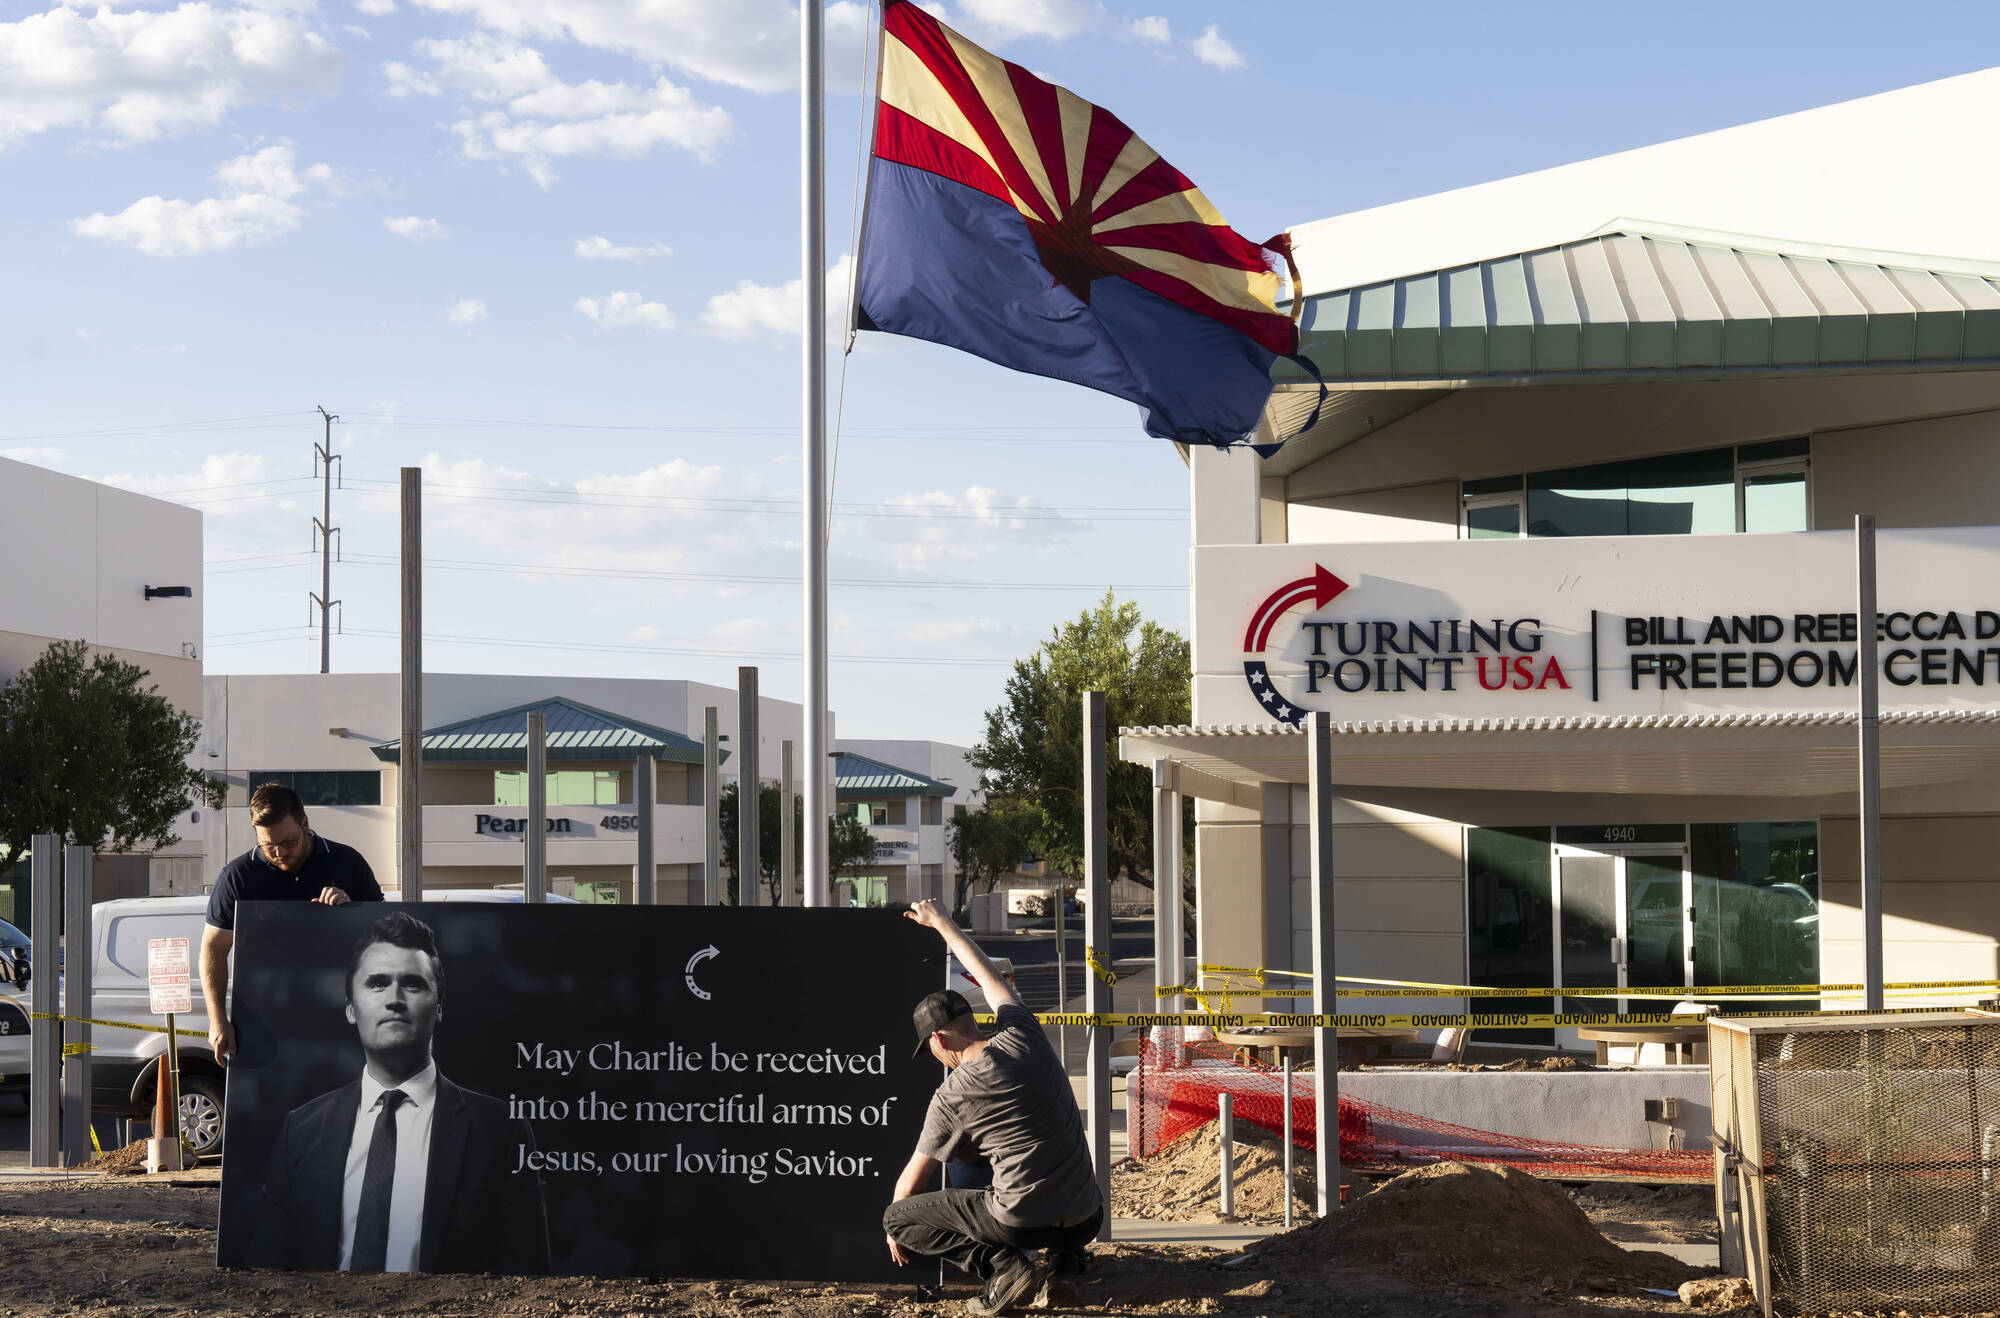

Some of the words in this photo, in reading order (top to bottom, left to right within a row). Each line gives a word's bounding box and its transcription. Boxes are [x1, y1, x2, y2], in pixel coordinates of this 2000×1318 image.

[1625, 616, 1695, 646] BILL
[1704, 614, 1784, 645] AND
[1302, 618, 1544, 656] TURNING
[1304, 657, 1463, 693] POINT
[1475, 656, 1572, 690] USA
[1631, 650, 1858, 690] FREEDOM
[475, 814, 572, 834] Pearon
[600, 815, 638, 829] 4950
[1604, 827, 1635, 841] 4940
[1046, 1014, 1101, 1026] CAUTION
[1127, 1015, 1182, 1026] CUIDADO
[1188, 1015, 1243, 1026] CAUTION
[1269, 1015, 1324, 1027] CUIDADO
[1330, 1014, 1386, 1027] CAUTION
[1412, 1014, 1467, 1026] CUIDADO
[1473, 1014, 1528, 1026] CAUTION
[1554, 1013, 1609, 1025] CUIDADO
[1615, 1013, 1671, 1024] CAUTION
[516, 1042, 581, 1075] May
[588, 1040, 703, 1071] Charlie
[710, 1042, 749, 1072] be
[756, 1044, 886, 1075] received
[508, 1093, 570, 1121] into
[578, 1091, 627, 1121] the
[635, 1093, 764, 1124] merciful
[772, 1101, 852, 1125] arms
[860, 1096, 898, 1126] of
[511, 1143, 603, 1176] Jesus,
[611, 1150, 668, 1173] our
[675, 1143, 768, 1183] loving
[774, 1148, 880, 1177] Savior.
